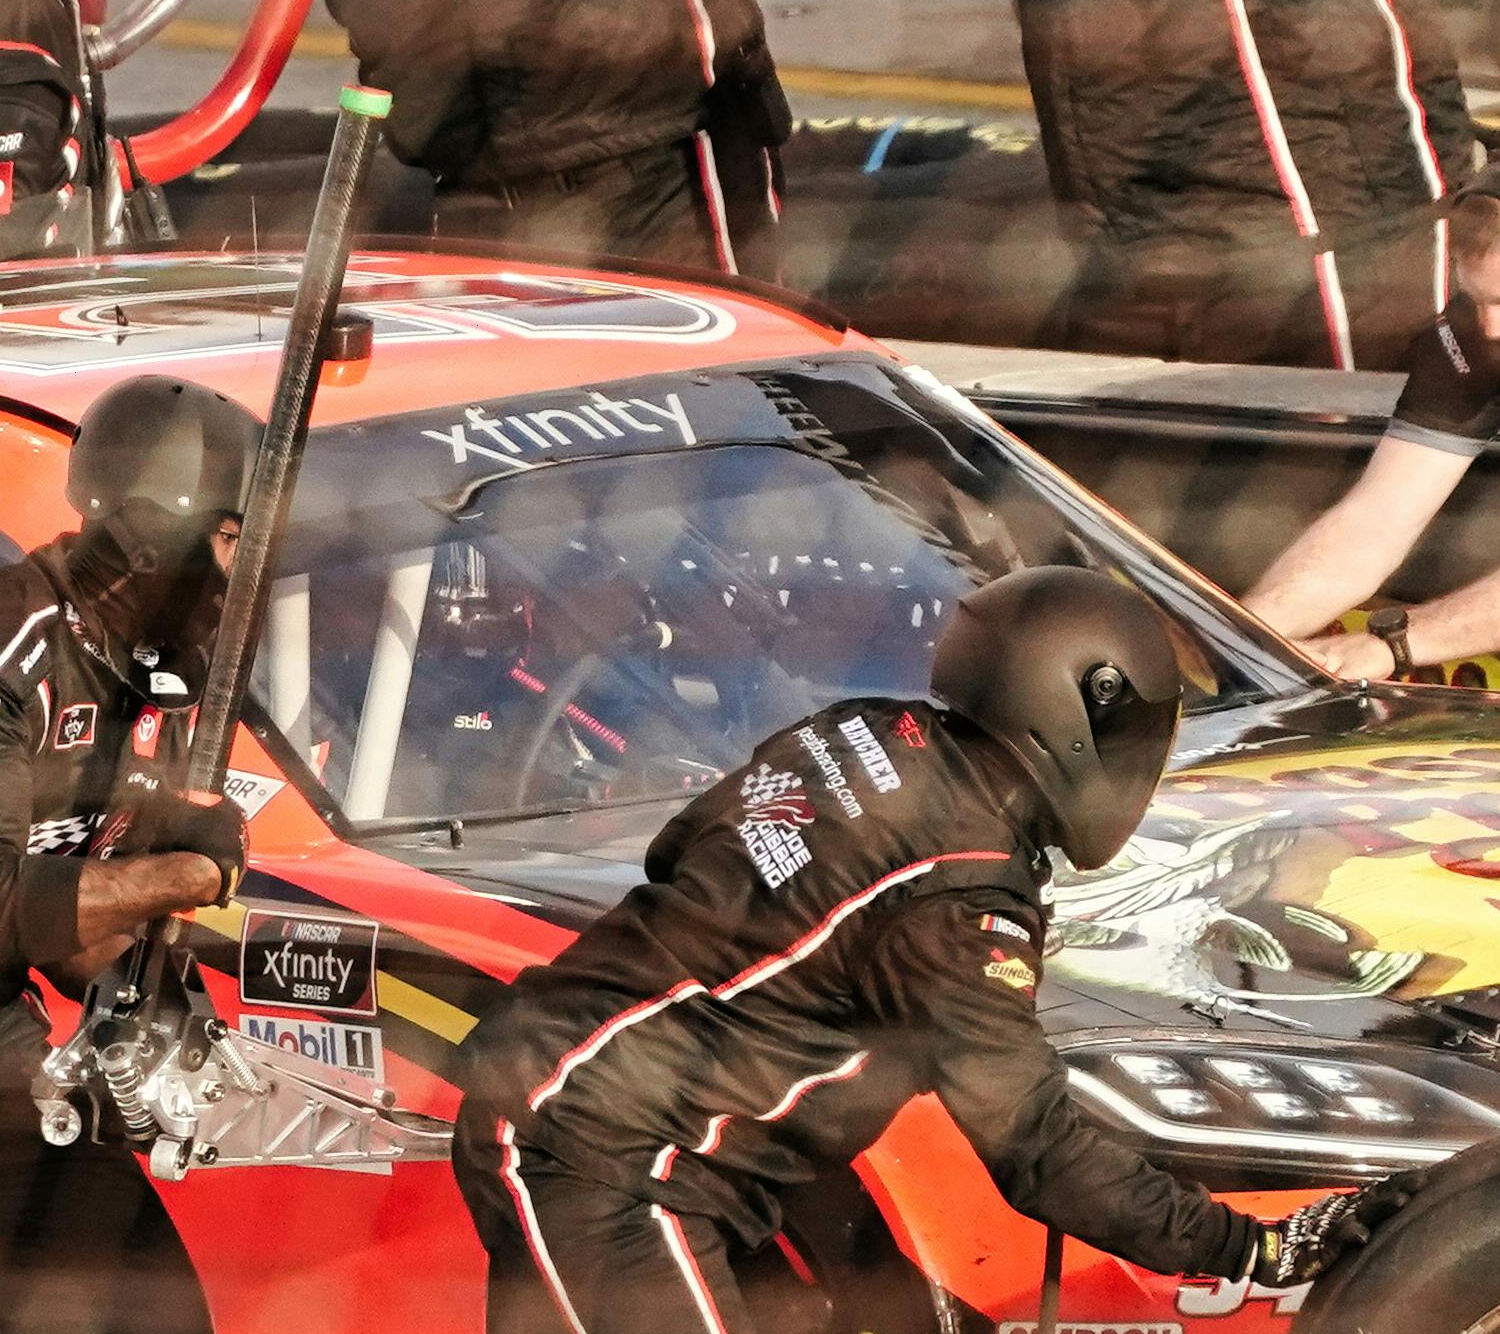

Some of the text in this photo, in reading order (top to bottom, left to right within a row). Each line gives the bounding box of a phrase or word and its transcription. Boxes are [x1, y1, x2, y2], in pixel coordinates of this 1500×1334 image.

[420, 391, 698, 469] xfinity
[837, 714, 902, 795] HATCHER
[737, 821, 787, 890] RACING
[755, 820, 801, 883] GIBBS
[779, 825, 813, 865] JOE
[294, 923, 342, 944] NASCAR
[262, 941, 354, 994] xfinity
[292, 983, 331, 1001] SERIES
[247, 1018, 338, 1066] Mobil
